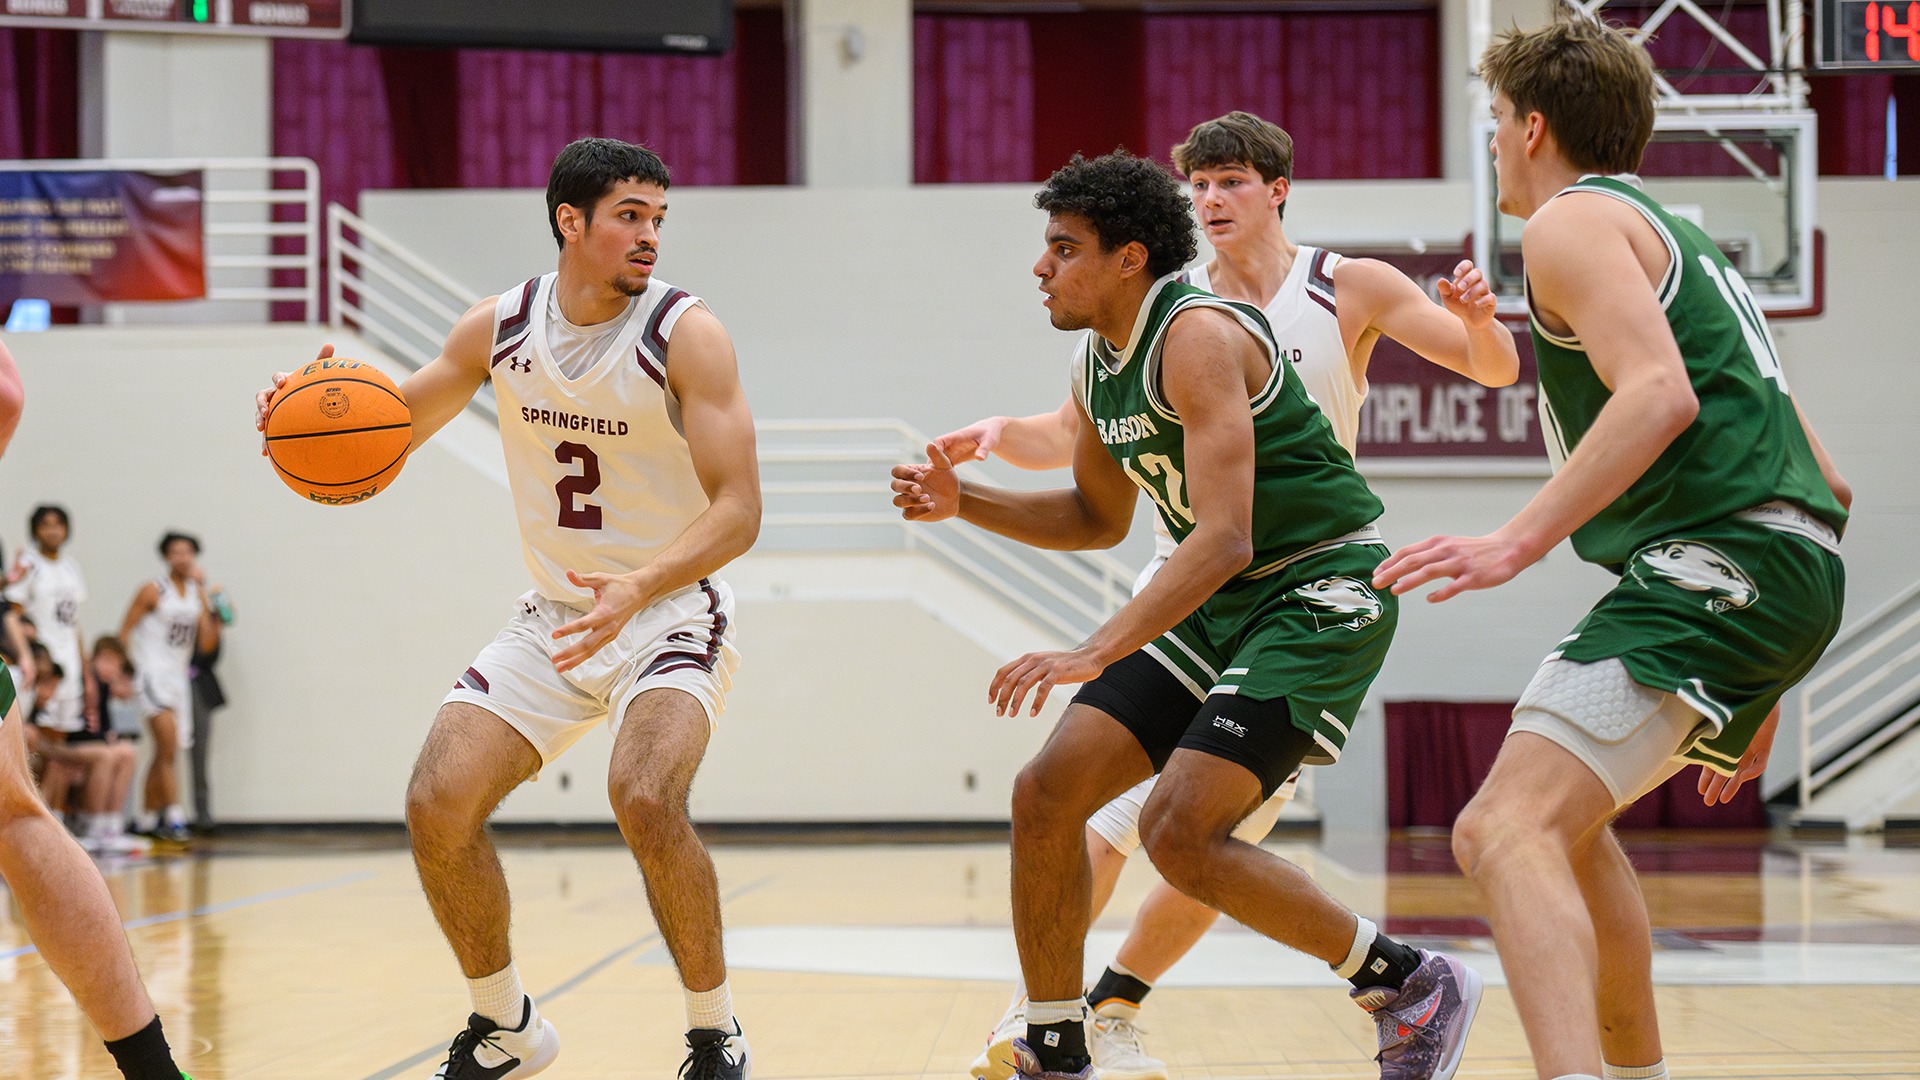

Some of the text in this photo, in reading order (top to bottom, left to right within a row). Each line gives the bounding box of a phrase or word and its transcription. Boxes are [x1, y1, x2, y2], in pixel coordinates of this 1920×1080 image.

[1865, 0, 1920, 62] 14
[521, 406, 628, 436] SPRINGFIELD
[1357, 384, 1487, 443] THPLACE
[1499, 385, 1535, 443] OF
[554, 440, 602, 530] 2
[1214, 715, 1247, 733] HEX
